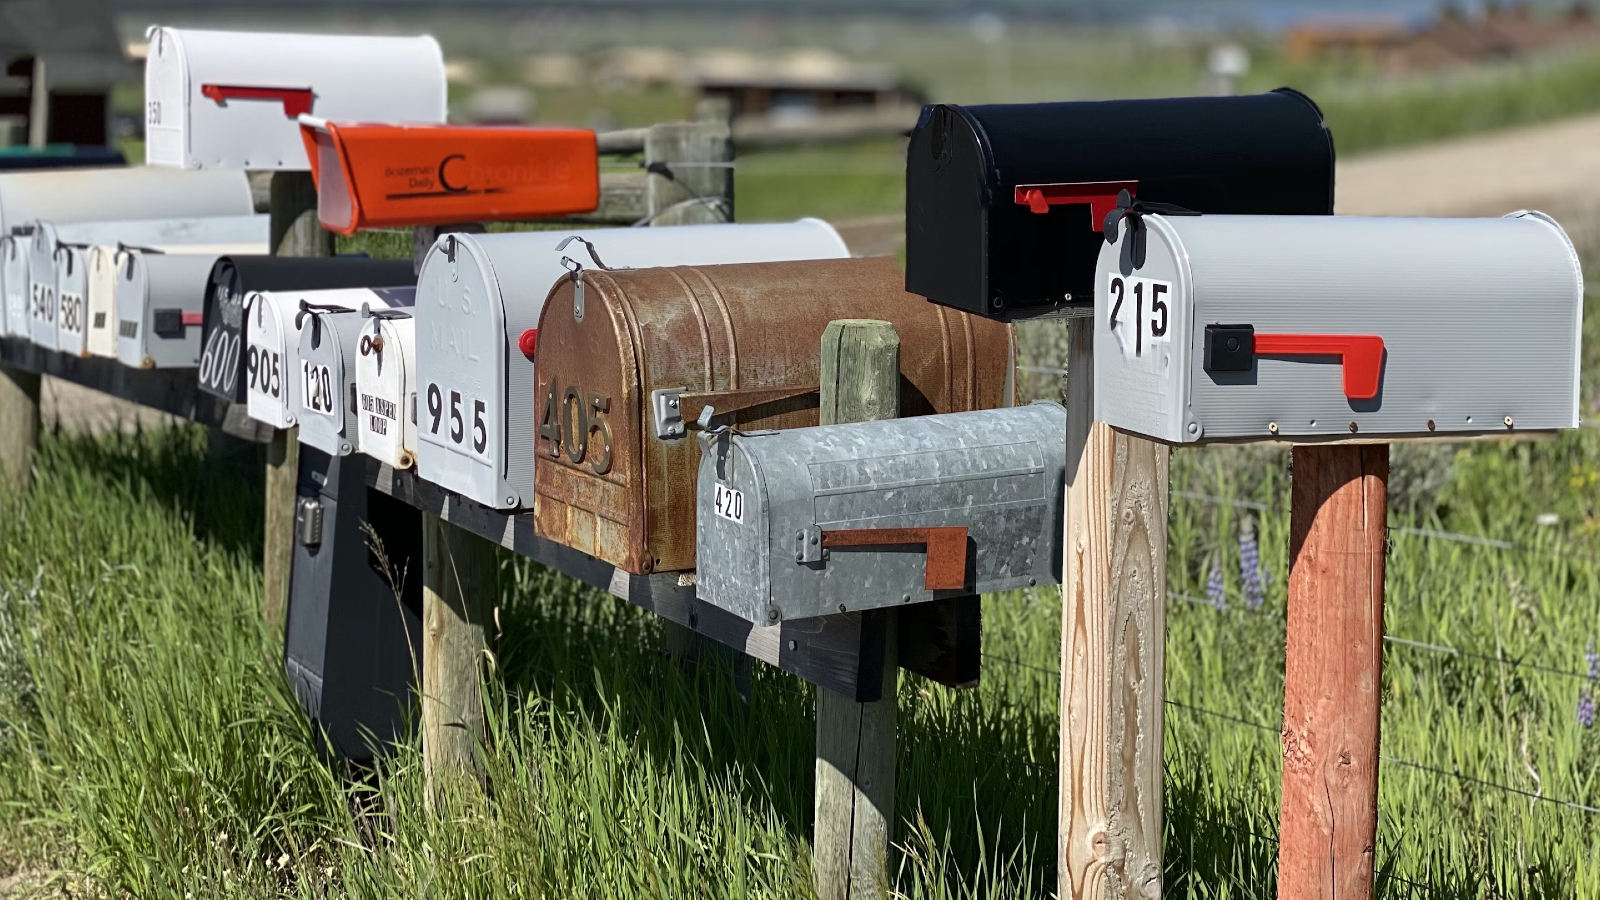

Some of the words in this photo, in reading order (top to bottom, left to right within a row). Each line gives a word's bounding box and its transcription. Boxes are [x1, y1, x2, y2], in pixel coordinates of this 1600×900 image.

[148, 101, 162, 125] 350
[384, 164, 435, 178] Bozeman
[408, 177, 435, 190] Daily
[438, 153, 570, 193] Chronicle
[33, 283, 54, 322] 540
[60, 295, 82, 334] 580
[1110, 277, 1168, 358] 215
[199, 326, 241, 392] 600
[430, 320, 479, 362] MAIL
[247, 344, 280, 398] 905
[304, 360, 333, 413] 120
[370, 415, 387, 435] LOOP
[375, 397, 397, 421] ASPEN
[427, 382, 487, 455] 955
[538, 375, 614, 475] 405
[715, 486, 742, 520] 420
